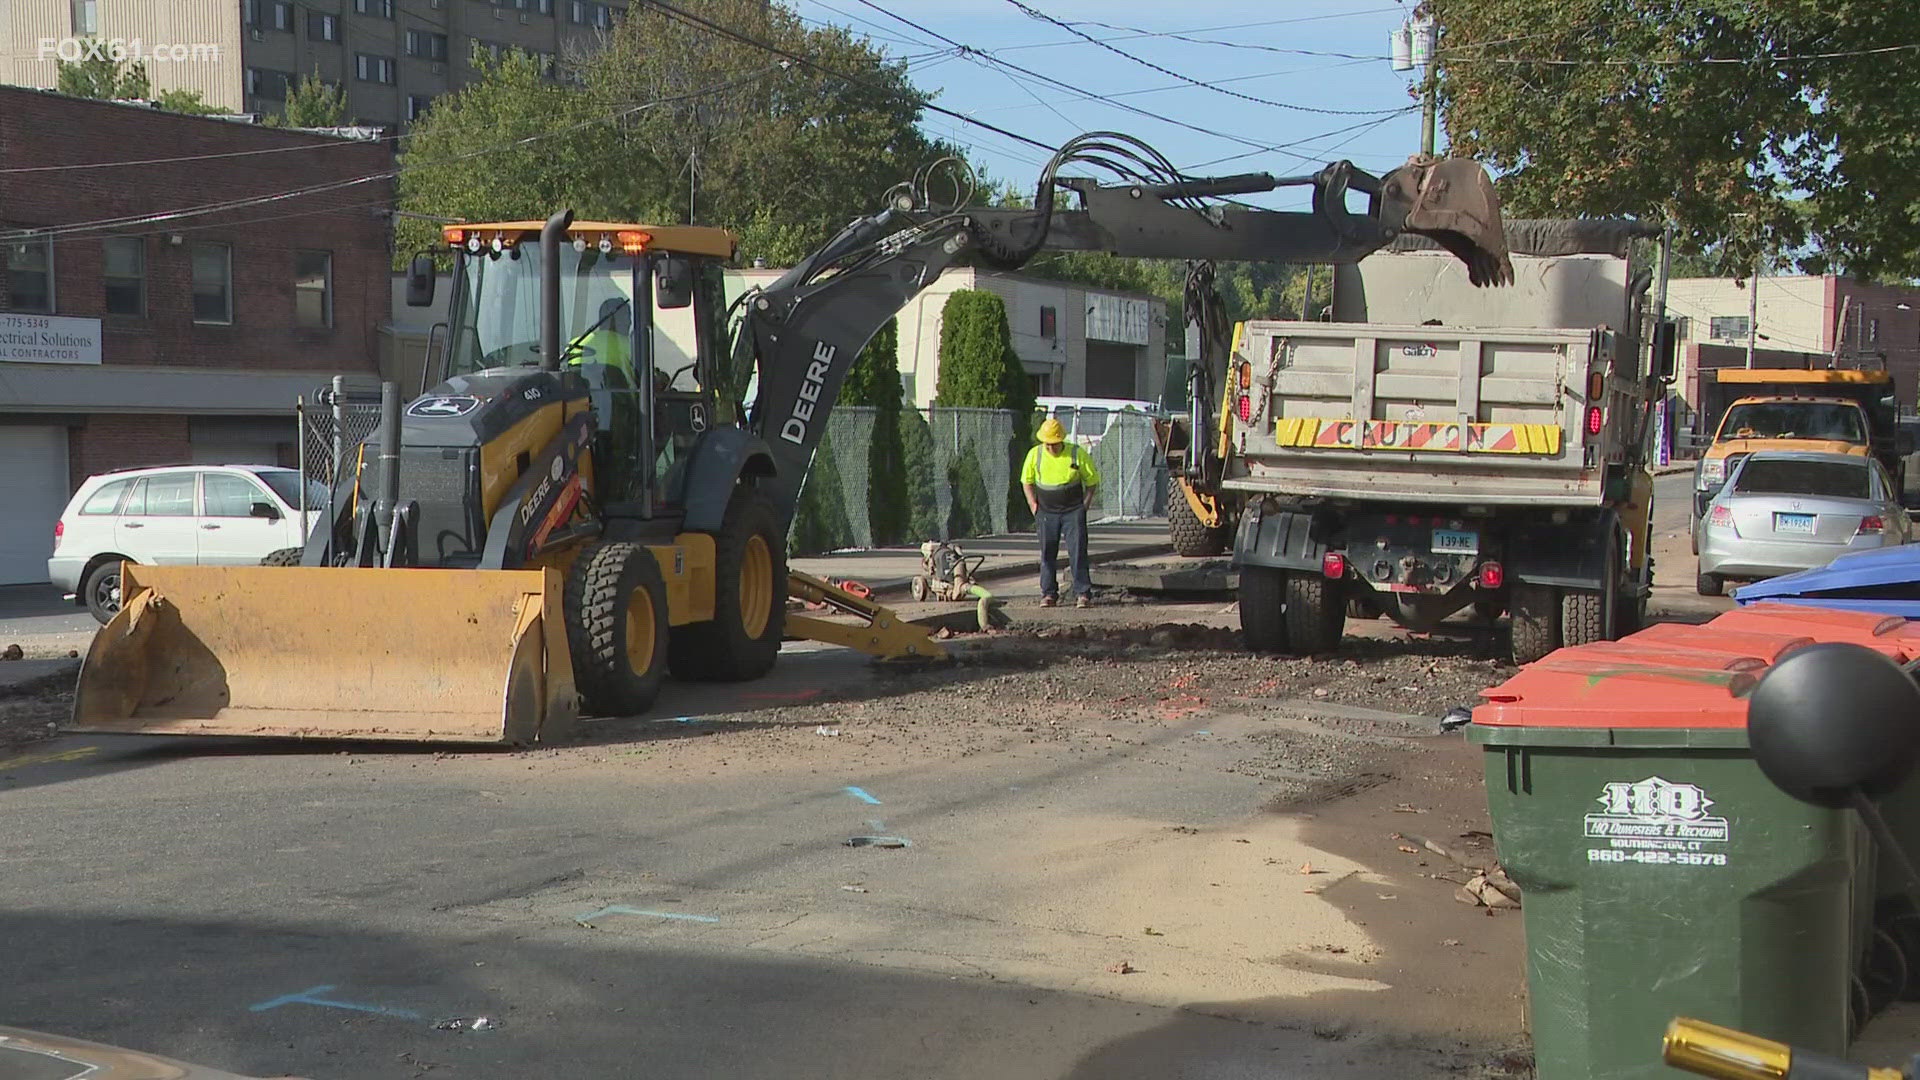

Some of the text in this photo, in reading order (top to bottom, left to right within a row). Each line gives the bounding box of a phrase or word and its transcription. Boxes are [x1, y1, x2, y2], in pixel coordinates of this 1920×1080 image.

[42, 332, 92, 348] Solutions
[11, 348, 79, 360] CONTRACTORS
[523, 388, 541, 401] 410
[780, 340, 836, 444] DEERE
[520, 475, 551, 527] DEERE
[1590, 822, 1609, 836] HQ
[1688, 841, 1702, 851] CT
[1587, 849, 1727, 866] 860-422-5678
